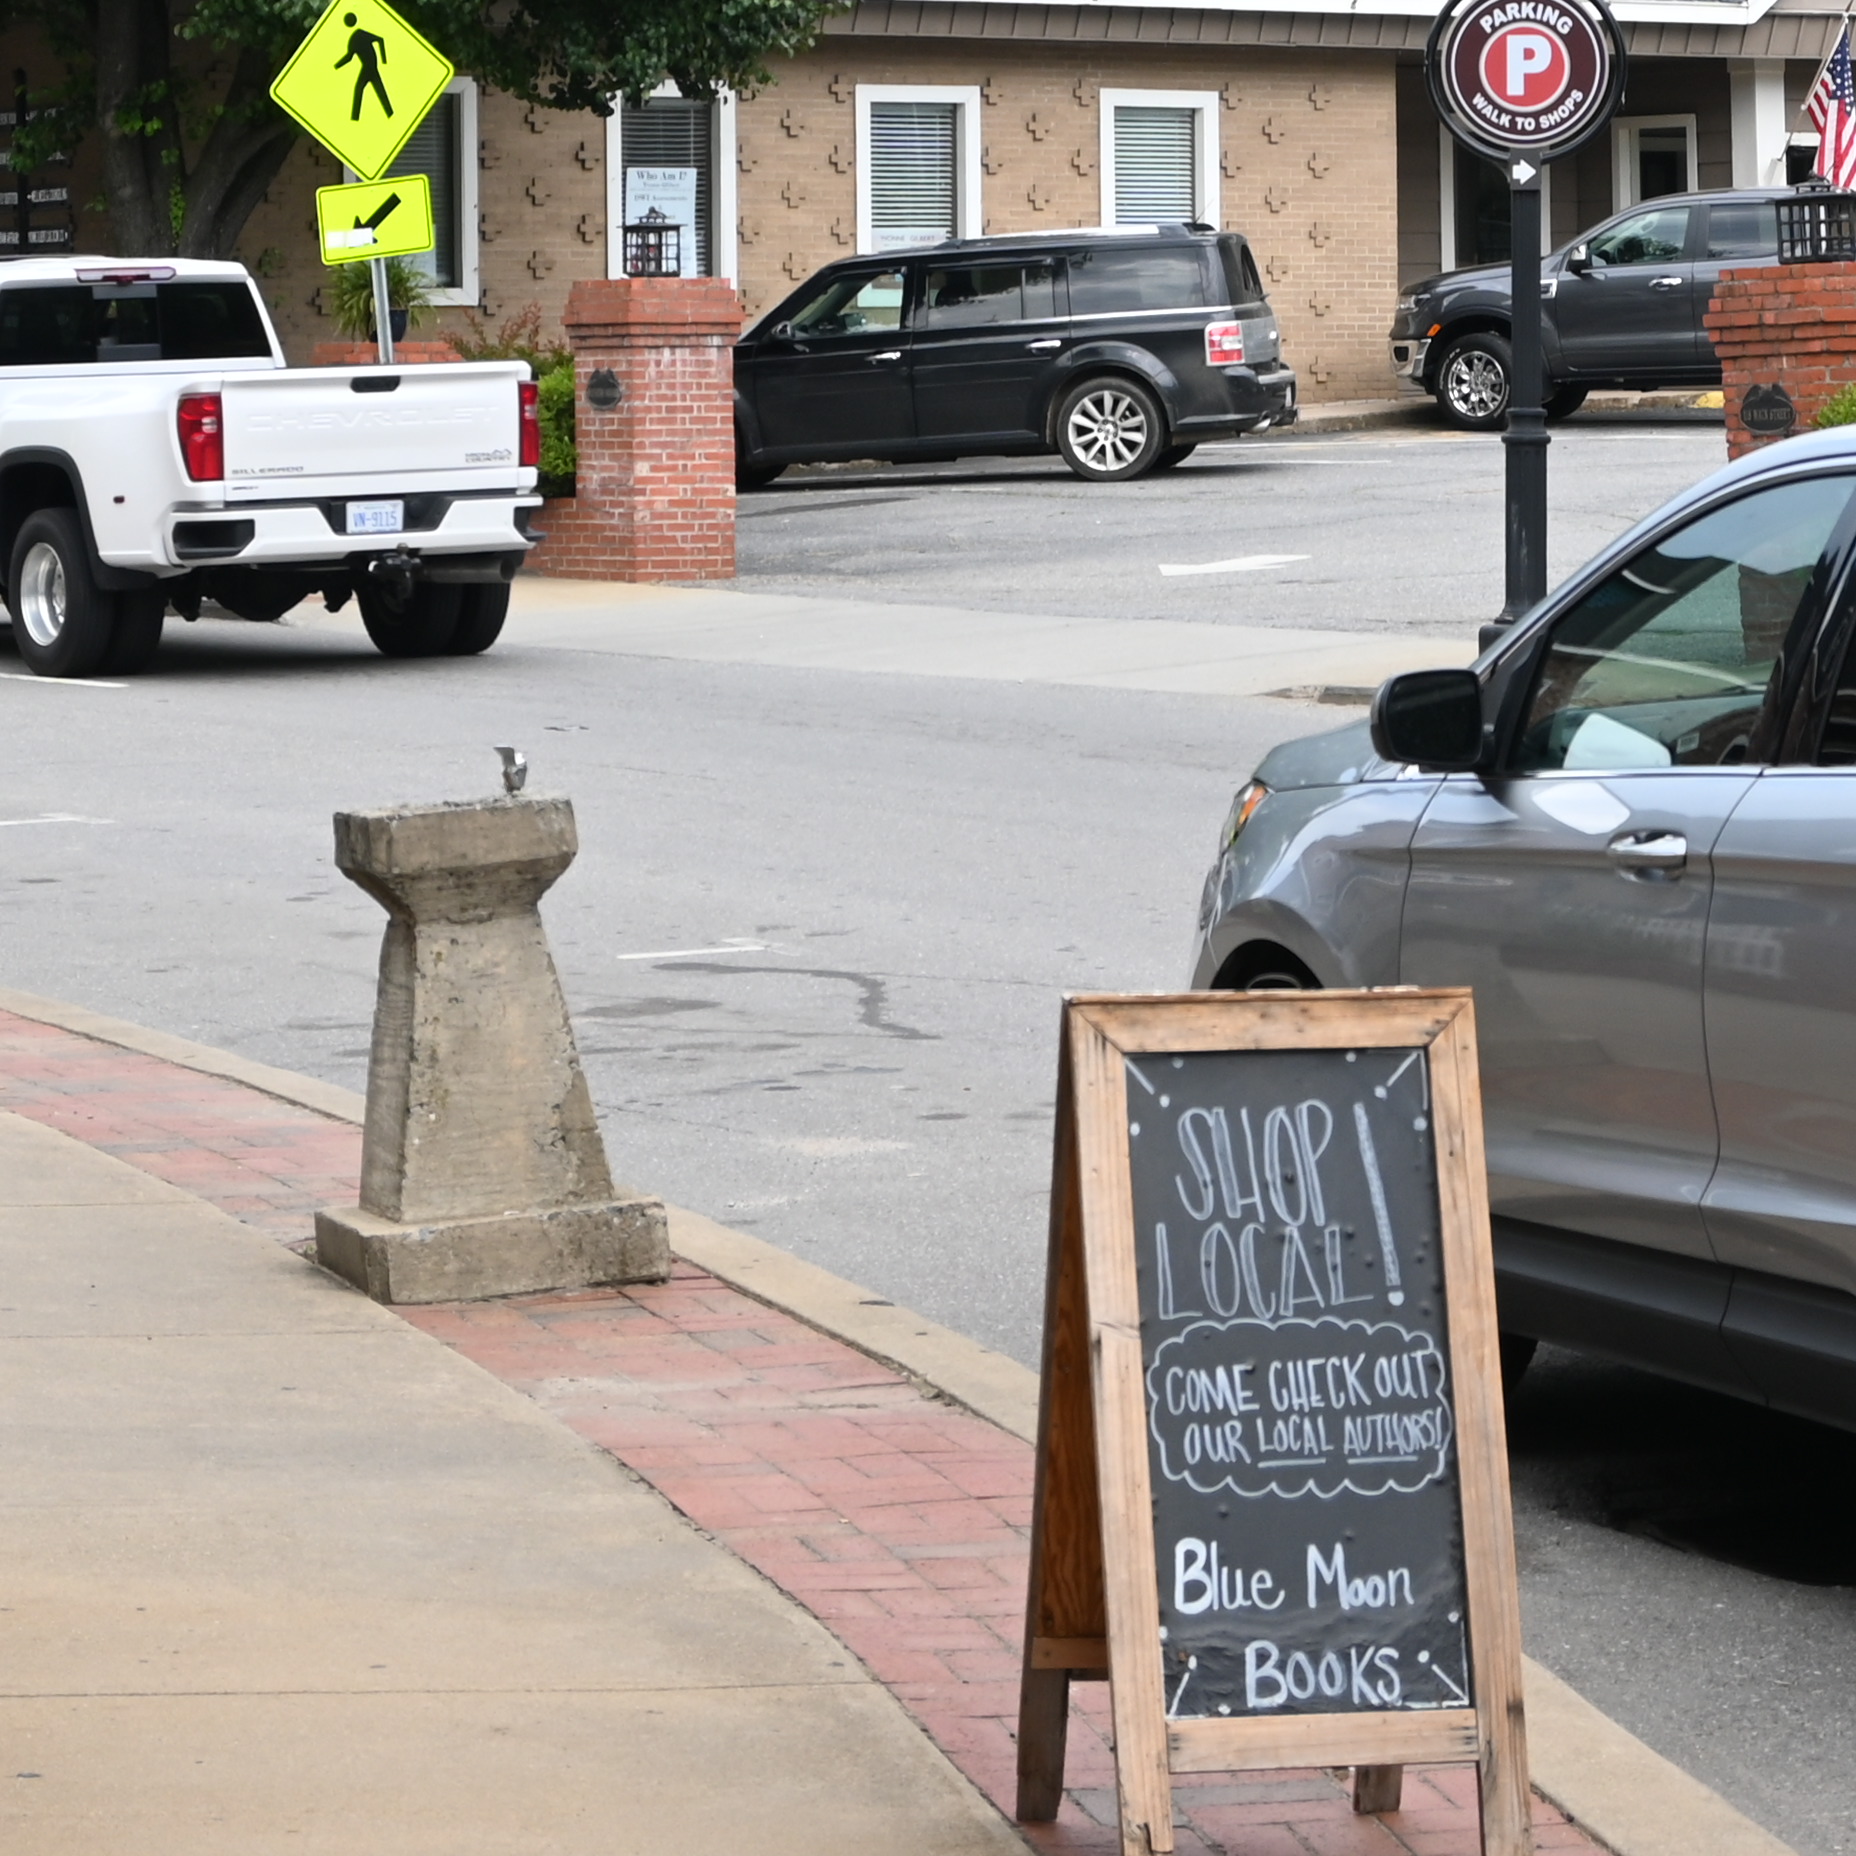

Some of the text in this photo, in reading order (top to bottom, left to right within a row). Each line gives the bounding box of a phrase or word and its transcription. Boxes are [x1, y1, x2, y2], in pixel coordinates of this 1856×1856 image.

[1479, 1, 1573, 35] PARKING
[1506, 34, 1552, 96] P
[1471, 89, 1584, 131] WALK TO SHOPS
[247, 407, 501, 432] CHEVROLET
[231, 466, 304, 475] SILVERADO
[1175, 1098, 1334, 1226] SHOP
[1165, 1350, 1431, 1416] COME CHECK OUT
[1183, 1406, 1444, 1465] OUR LOCAL AUTHORS!
[1174, 1537, 1415, 1616] Blue Moon
